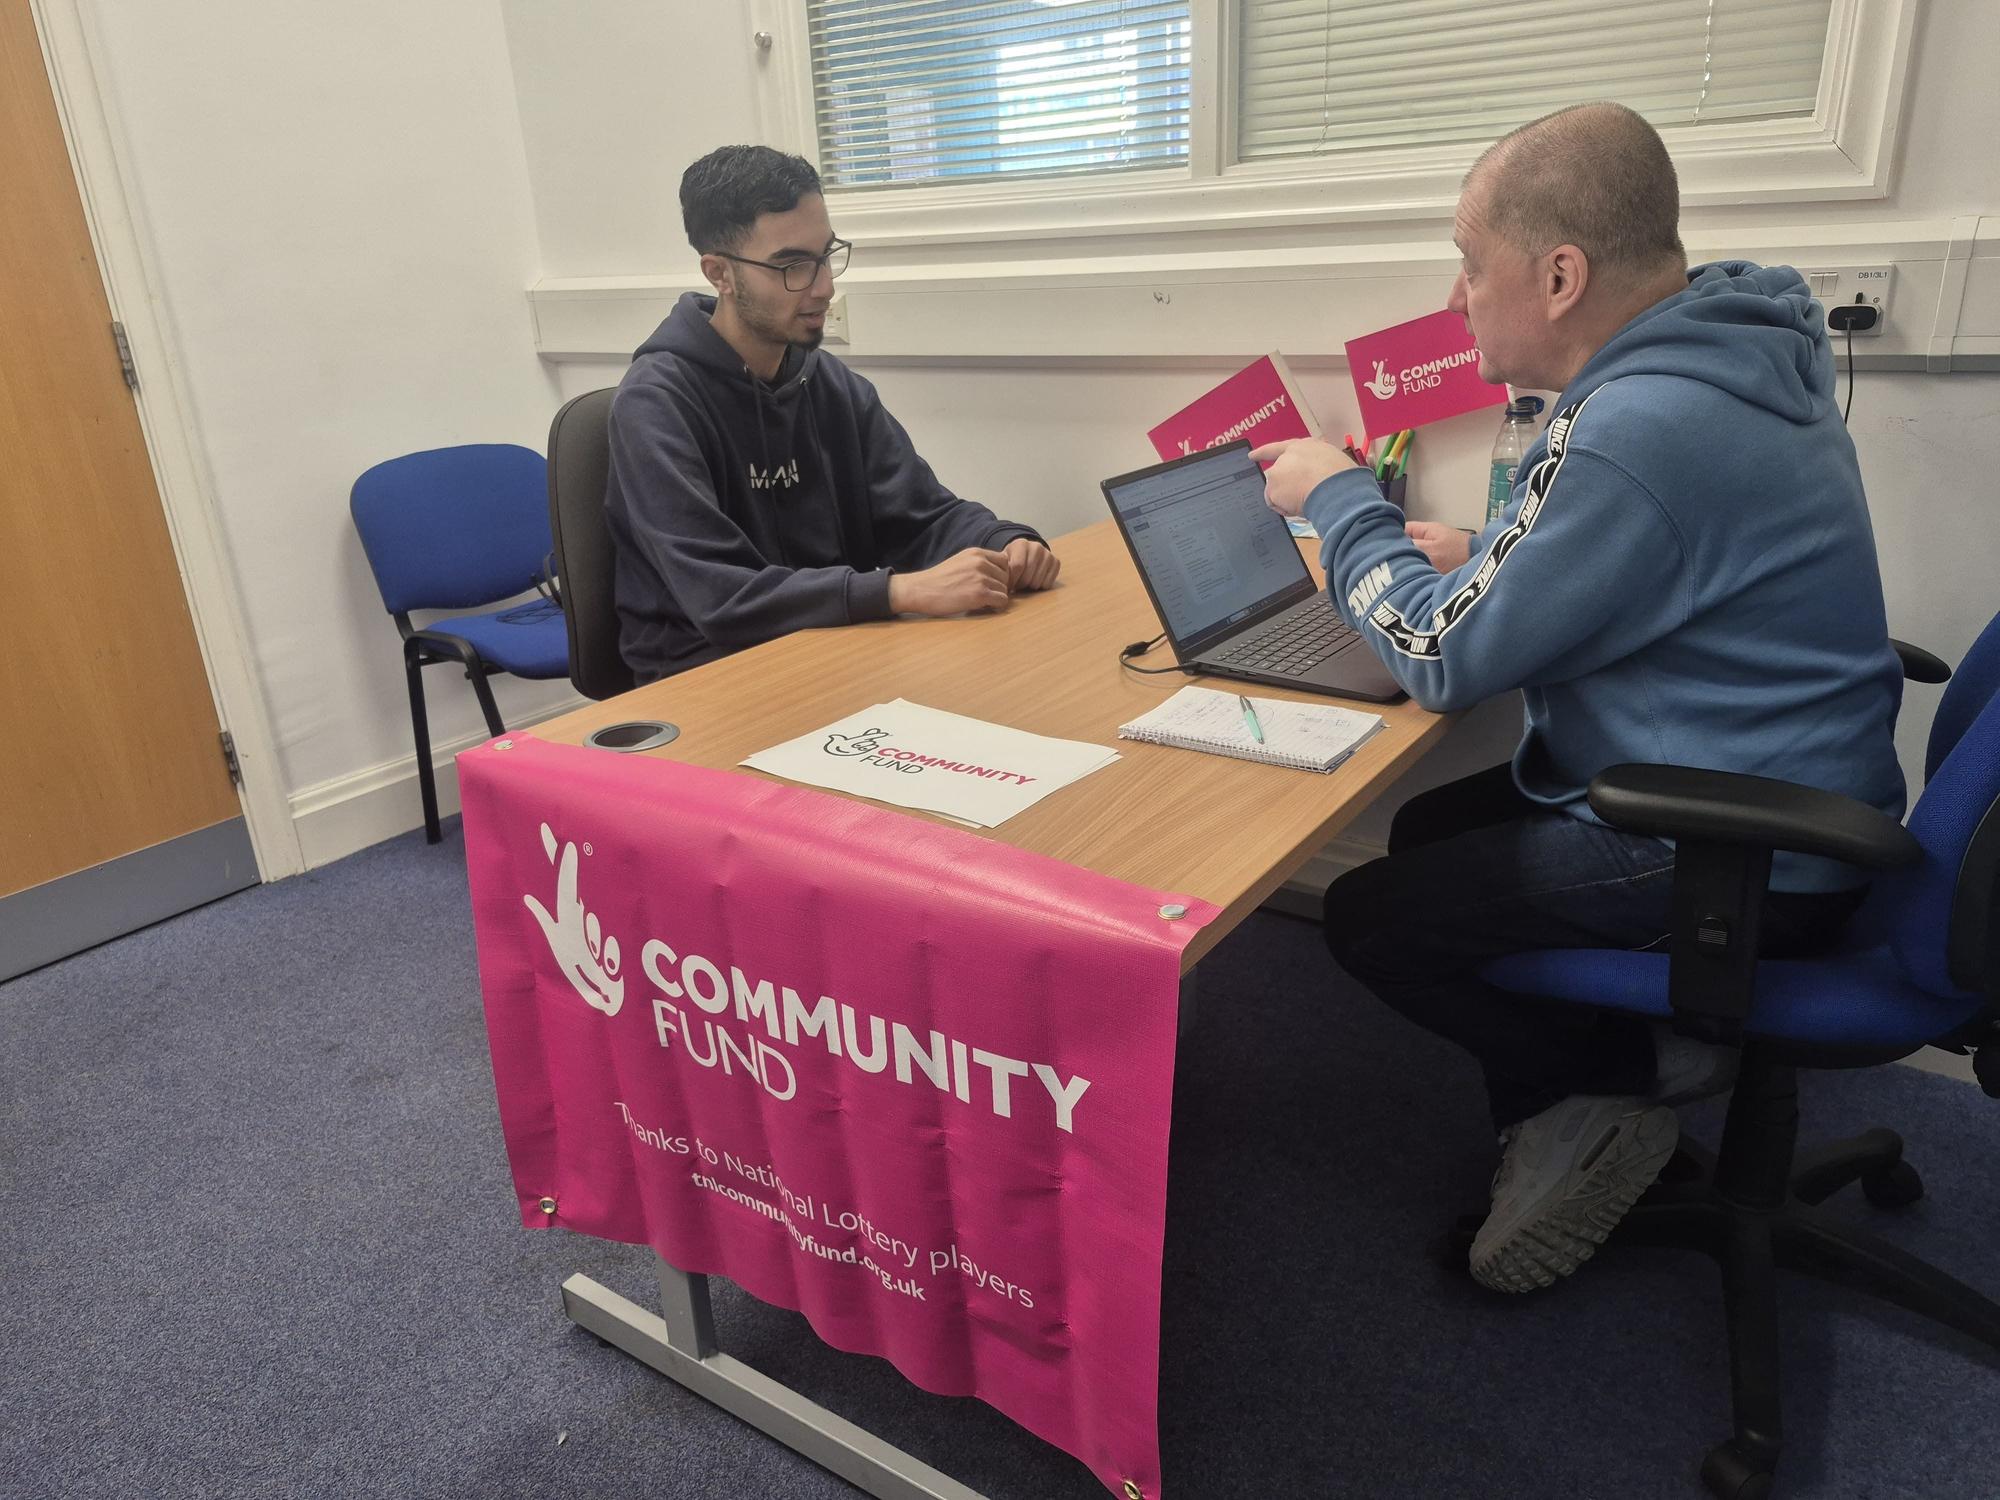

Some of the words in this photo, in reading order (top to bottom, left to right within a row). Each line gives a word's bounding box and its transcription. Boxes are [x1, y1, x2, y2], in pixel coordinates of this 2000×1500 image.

[1400, 348, 1482, 382] COMMUNI
[1402, 375, 1441, 396] FUND
[1206, 394, 1287, 450] COMMUNITY
[1551, 418, 1570, 454] NIKE
[1521, 489, 1539, 530] NIKE
[1348, 561, 1393, 618] NIKE
[1475, 554, 1497, 592] NIKE
[859, 754, 924, 774] FUND
[878, 748, 1037, 785] COMMUNITY
[641, 938, 1092, 1134] COMMUNITY
[652, 999, 797, 1101] FUND
[614, 1102, 690, 1154] Thanks
[695, 1137, 719, 1165] to
[723, 1151, 815, 1220] National
[822, 1203, 918, 1268] Lottery
[929, 1244, 1034, 1309] players
[692, 1172, 926, 1301] tnlcommunityfund.org.uk
